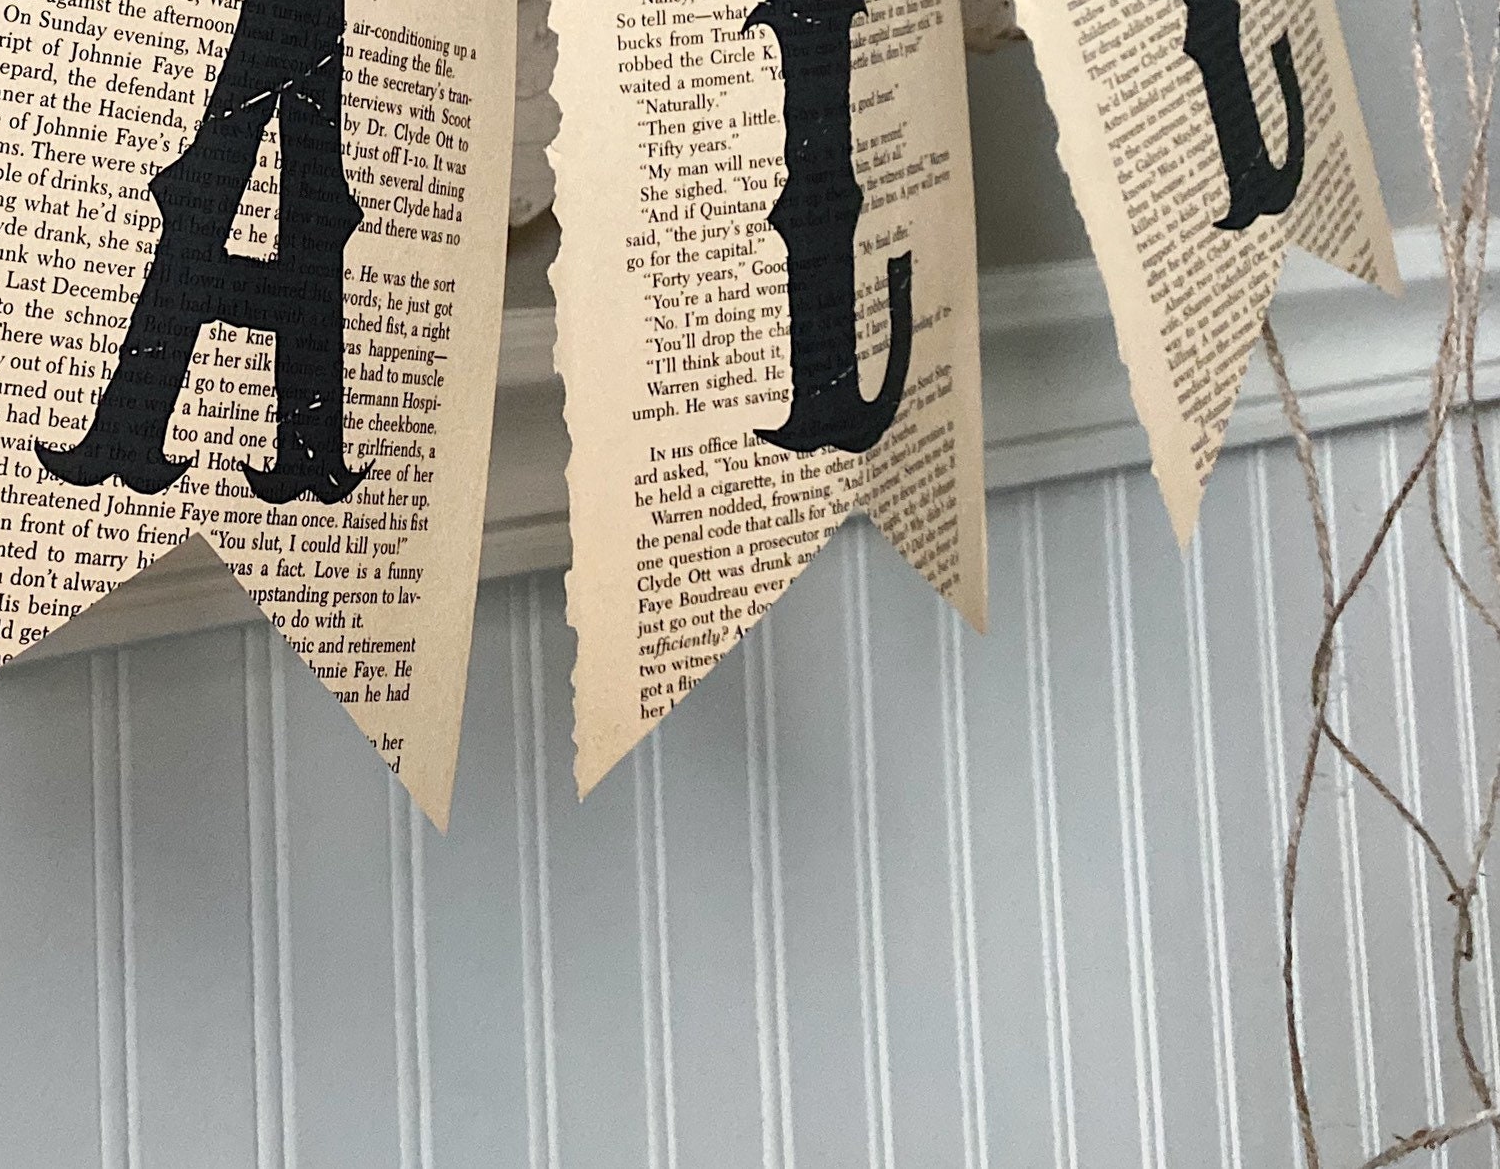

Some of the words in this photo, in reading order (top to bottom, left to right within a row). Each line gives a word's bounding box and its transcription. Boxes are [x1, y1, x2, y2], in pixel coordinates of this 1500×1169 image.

[618, 53, 673, 73] robbed
[680, 51, 703, 67] the
[710, 47, 754, 64] Circle
[763, 46, 777, 59] K.
[692, 119, 722, 135] give
[729, 118, 736, 128] a
[742, 109, 781, 127] little.
[34, 221, 90, 249] drank,
[98, 230, 129, 251] she
[650, 447, 666, 461] IN
[672, 445, 694, 459] HIS
[699, 437, 738, 456] office
[252, 531, 282, 554] slut,
[289, 535, 296, 551] I
[301, 535, 341, 553] could
[346, 535, 368, 554] kill
[48, 546, 64, 563] to
[74, 552, 128, 571] marry
[260, 563, 268, 576] a
[276, 558, 305, 577] fact.
[314, 561, 349, 579] Love
[356, 563, 368, 579] is
[374, 567, 381, 579] a
[388, 561, 424, 583] funny
[638, 572, 681, 593] Clyde
[688, 569, 711, 583] Ott
[718, 565, 744, 578] was
[751, 552, 792, 573] drunk
[638, 598, 672, 614] Faye
[680, 586, 748, 607] Boudreau
